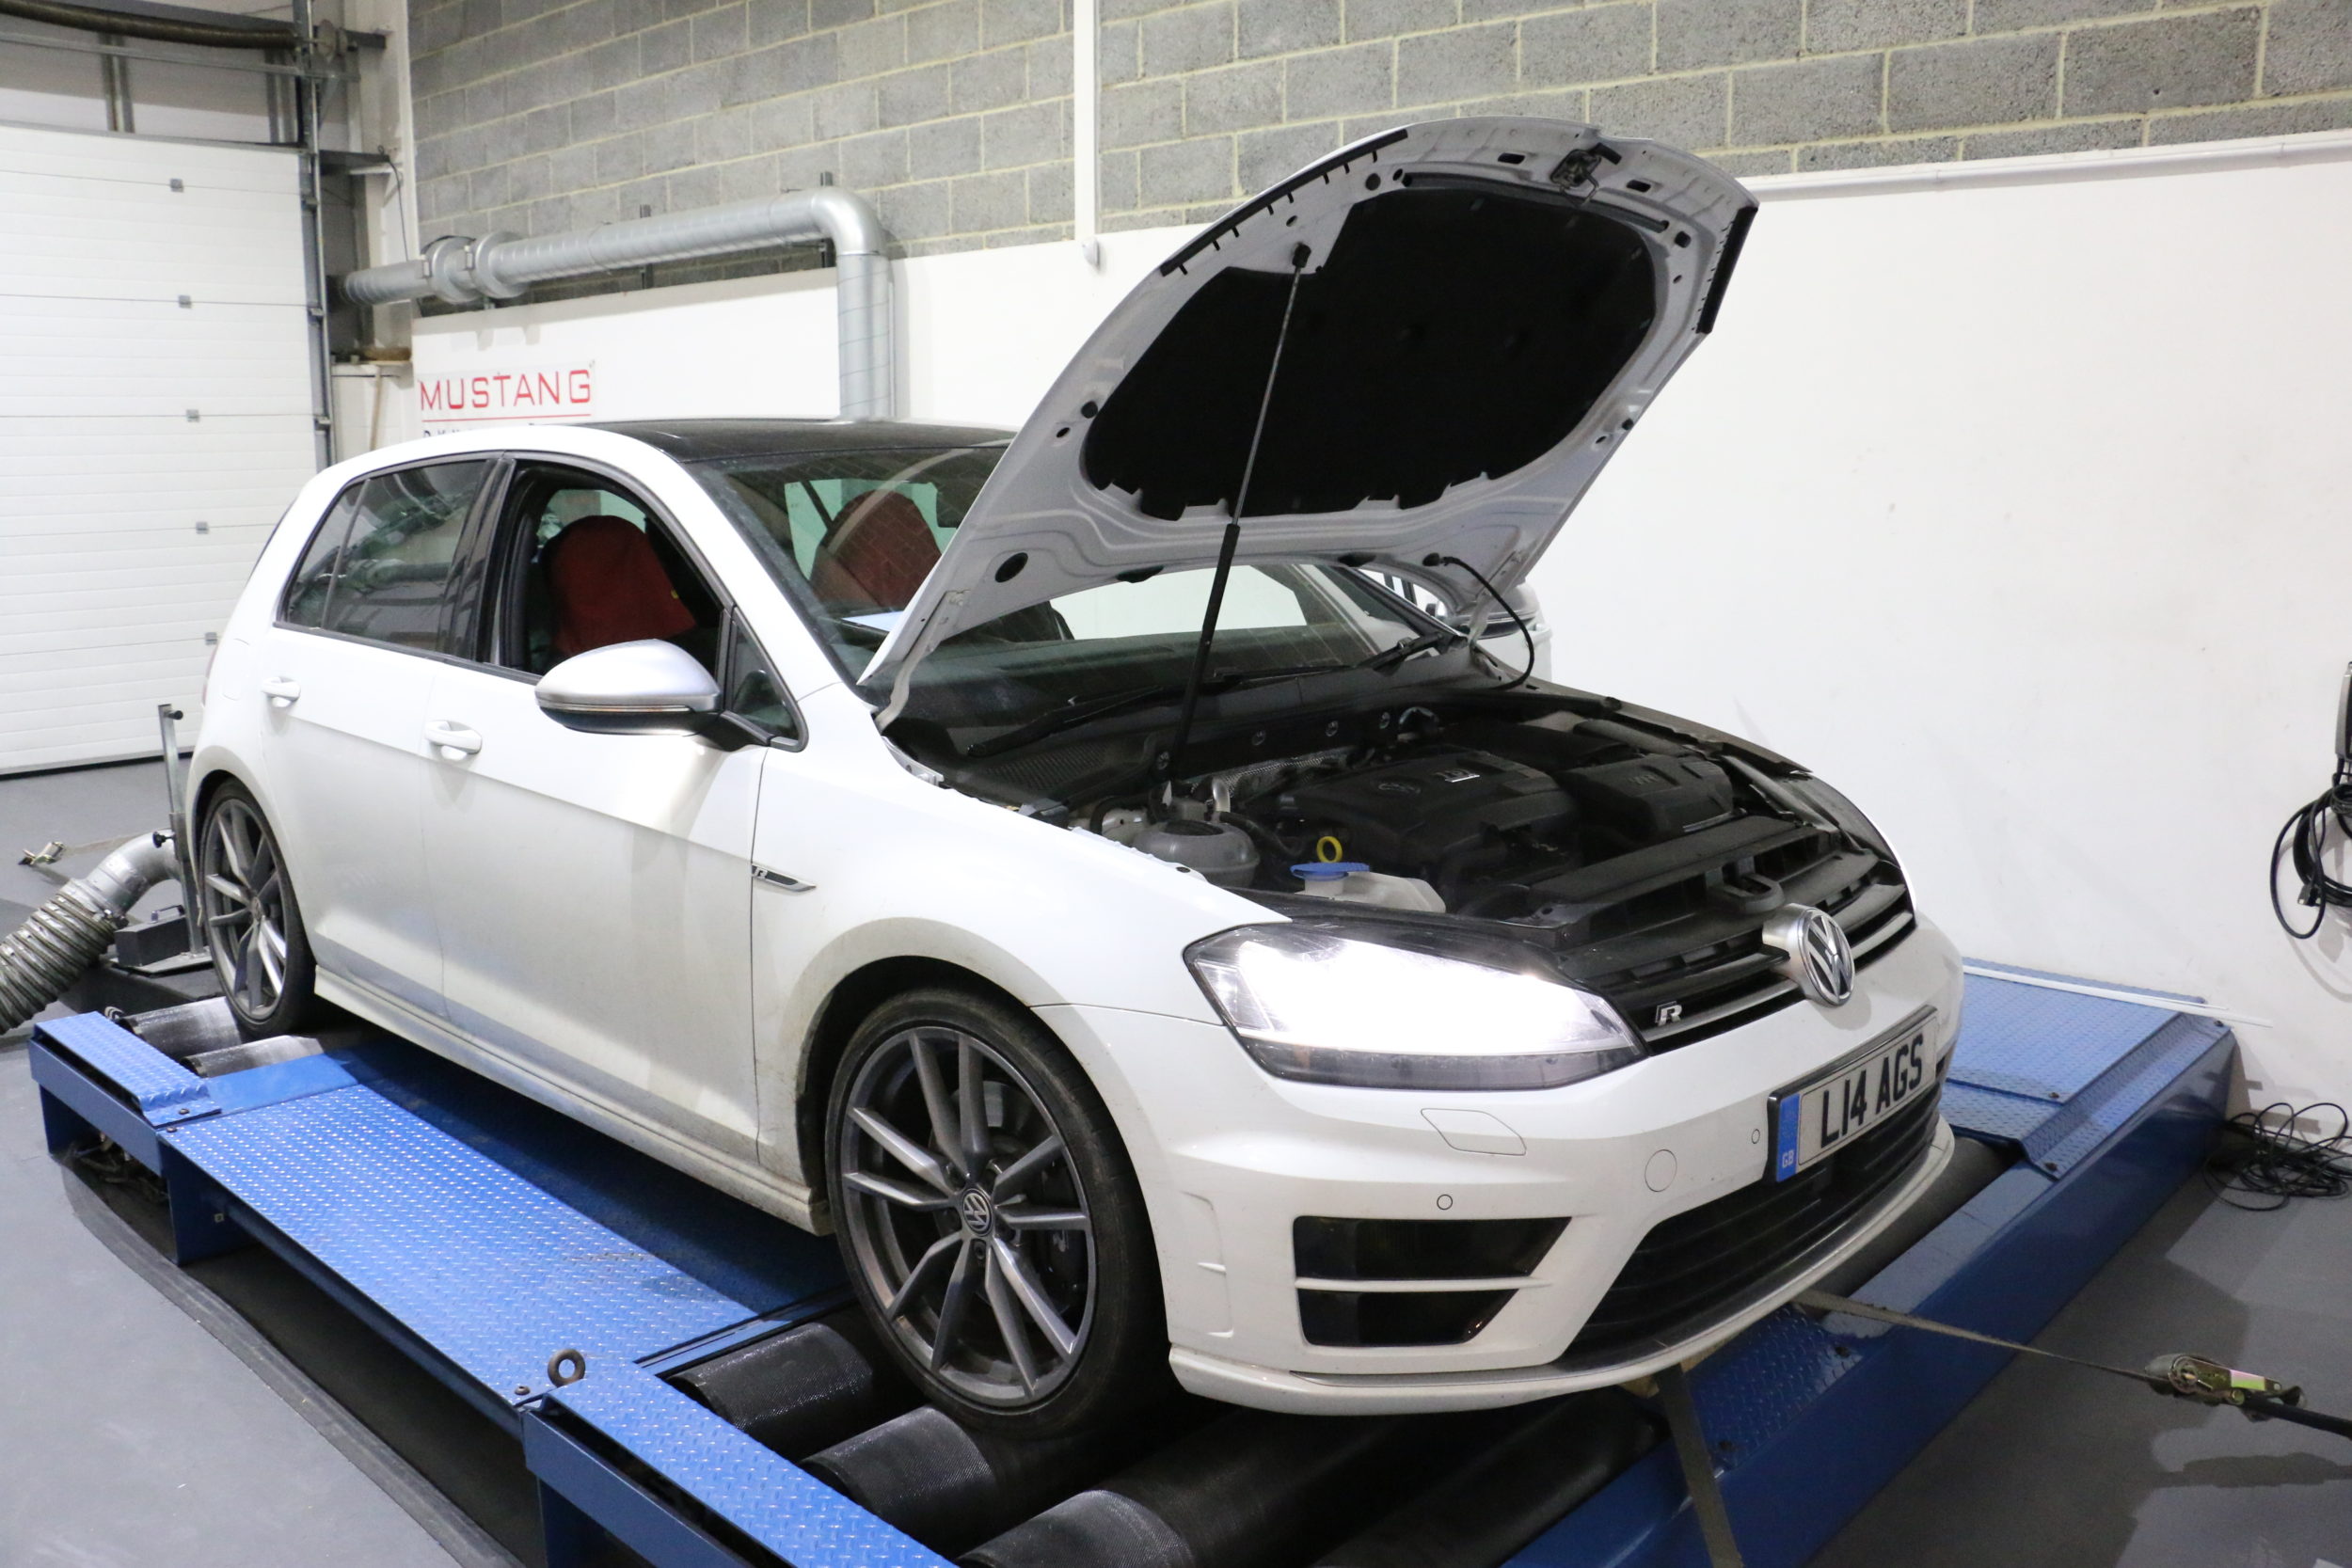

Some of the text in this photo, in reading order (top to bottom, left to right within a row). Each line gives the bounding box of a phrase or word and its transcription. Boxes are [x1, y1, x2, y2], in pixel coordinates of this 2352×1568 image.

[420, 370, 591, 411] MUSTANG
[1655, 1001, 1683, 1026] R
[1820, 1033, 1924, 1148] L14 AGS
[1781, 1149, 1795, 1167] GB
